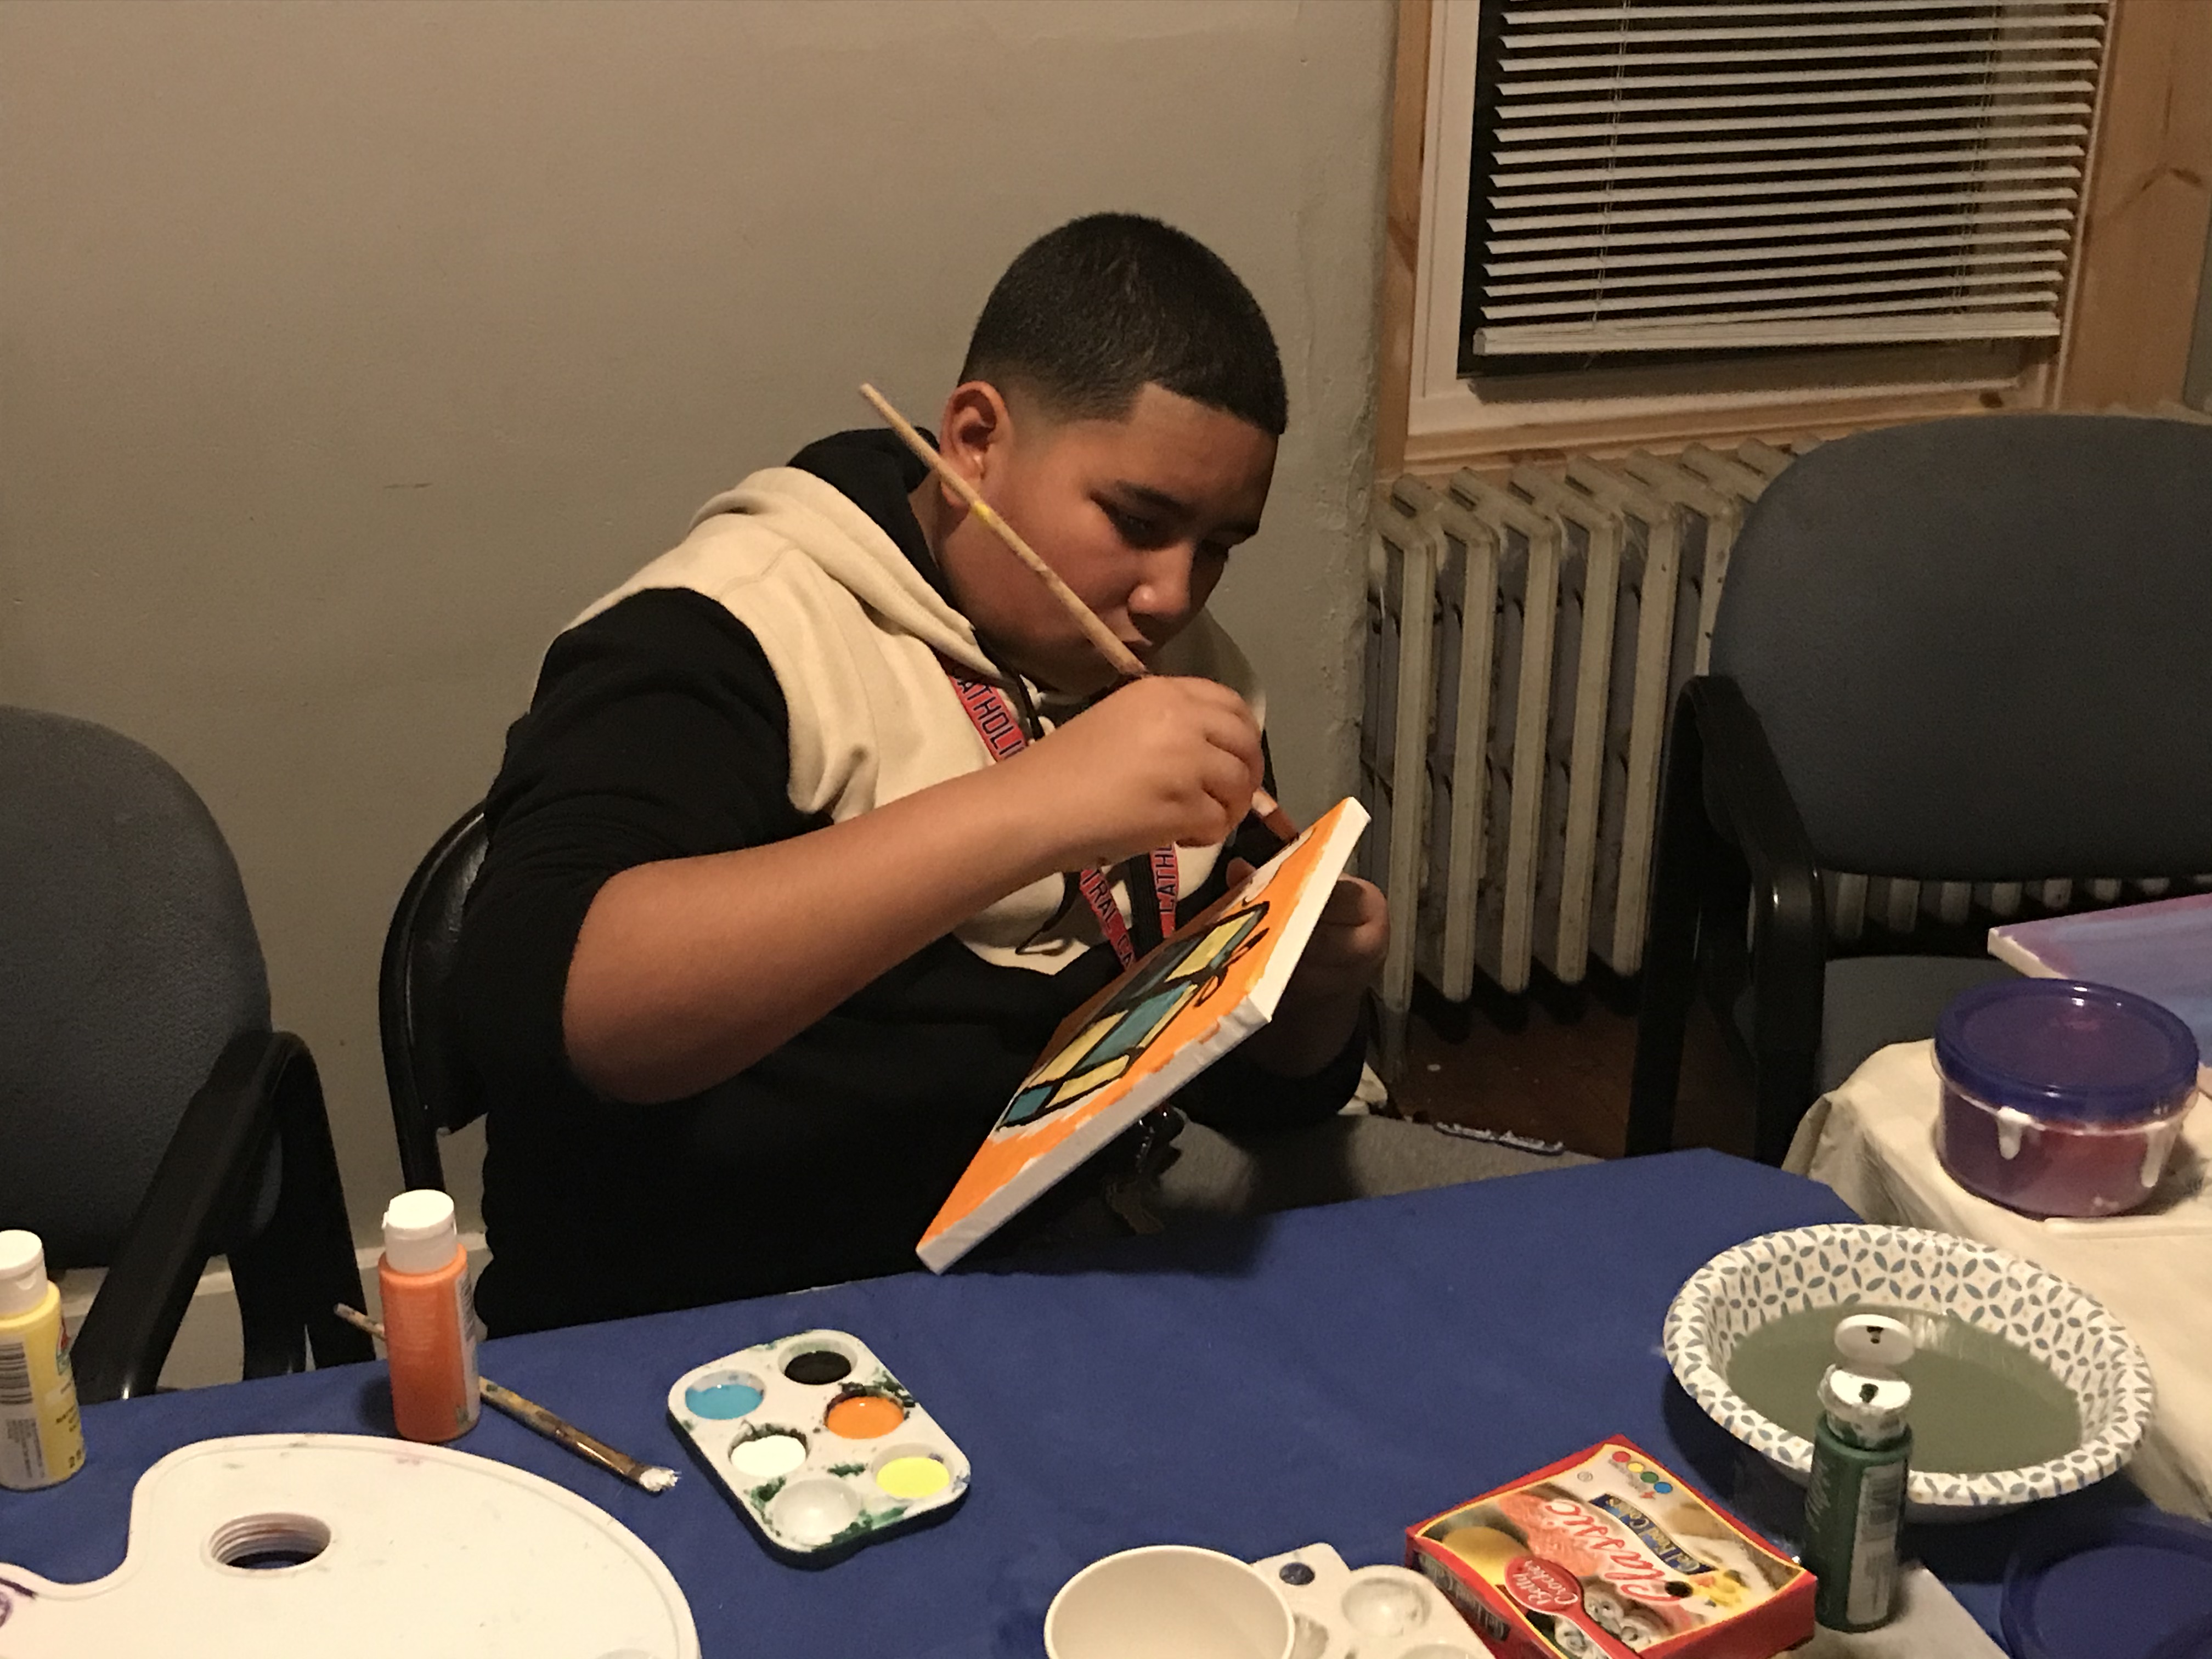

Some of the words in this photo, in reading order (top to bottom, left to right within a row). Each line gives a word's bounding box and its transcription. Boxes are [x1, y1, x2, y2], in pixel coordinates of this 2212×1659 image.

[957, 678, 1025, 760] ATHOLI
[1117, 934, 1133, 967] CA
[1545, 1503, 1682, 1601] Classic
[1513, 1572, 1553, 1605] Betty
[1524, 1560, 1579, 1605] Crocker
